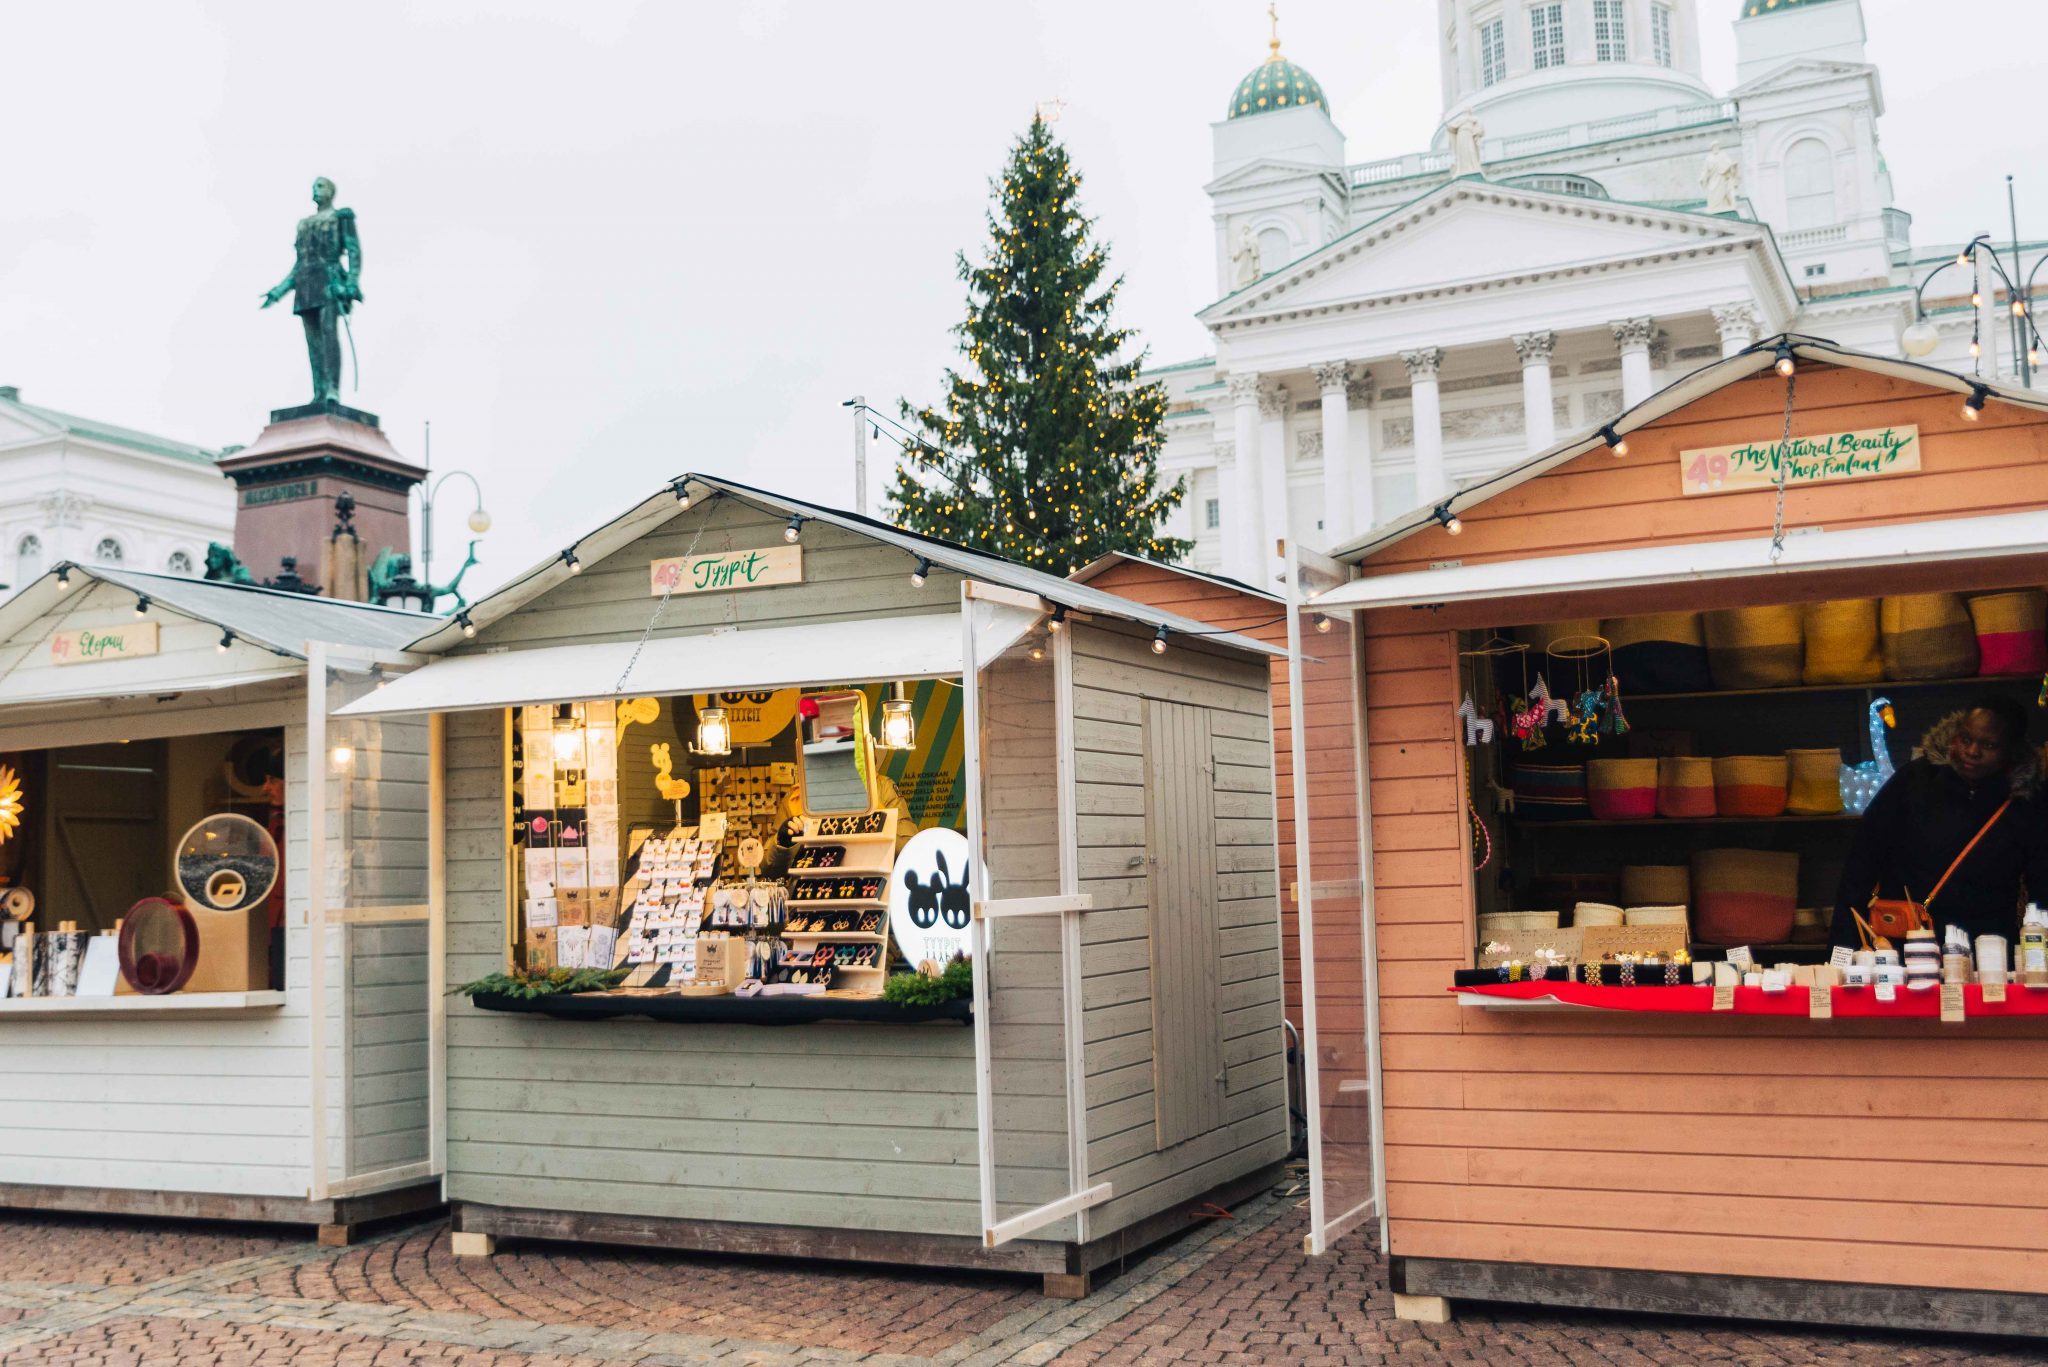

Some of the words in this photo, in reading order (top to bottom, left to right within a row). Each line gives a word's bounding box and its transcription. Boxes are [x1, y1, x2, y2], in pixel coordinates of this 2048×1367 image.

[1731, 444, 1766, 472] The
[1754, 436, 1832, 472] Natural
[1836, 428, 1914, 464] Beauty
[1822, 452, 1881, 480] Finland
[1686, 453, 1728, 485] 49
[692, 551, 770, 589] Tyypit
